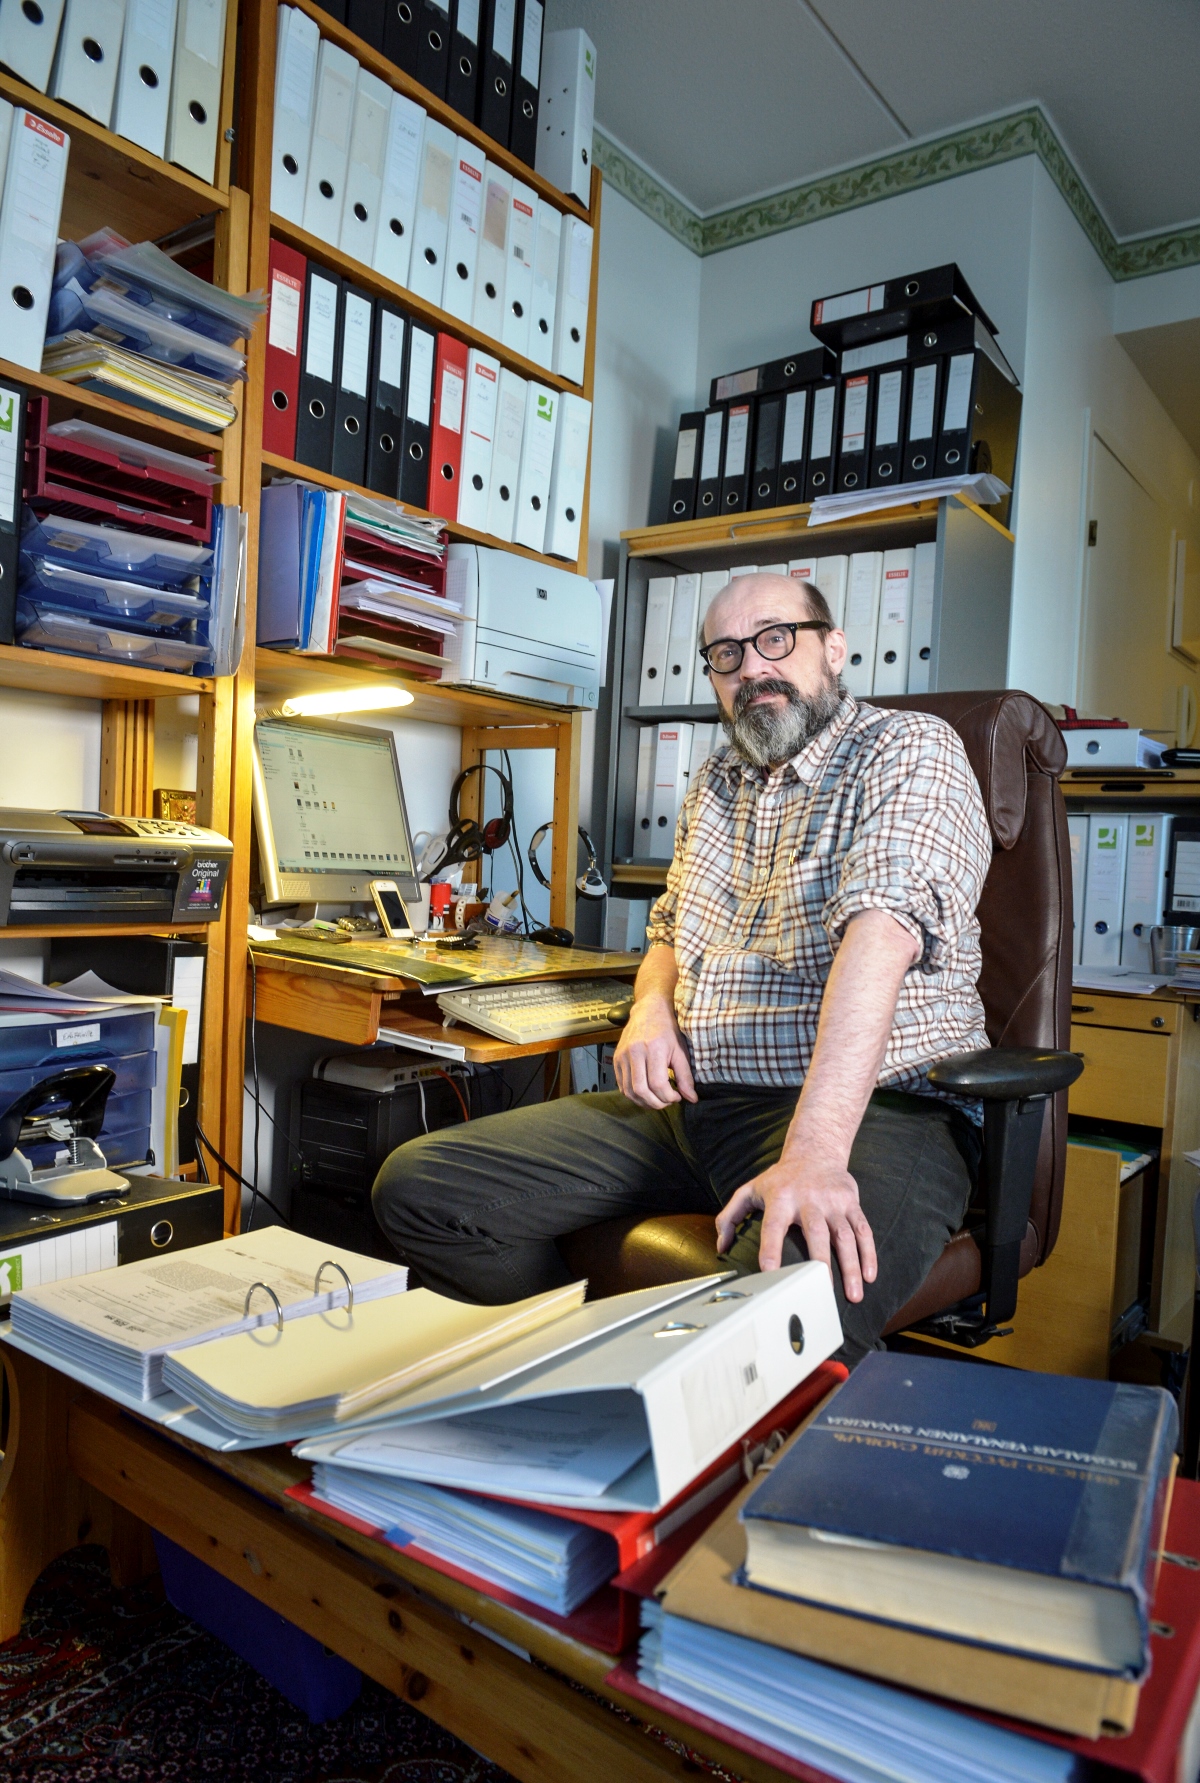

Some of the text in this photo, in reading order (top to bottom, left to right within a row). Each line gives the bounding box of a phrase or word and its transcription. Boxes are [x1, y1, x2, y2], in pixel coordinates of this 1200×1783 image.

[36, 123, 61, 142] Esselte
[462, 163, 479, 179] ESSELTE
[276, 273, 298, 288] ESSELTE
[197, 860, 218, 869] brother
[191, 868, 220, 879] Original
[827, 1415, 914, 1434] SANAKIRJA
